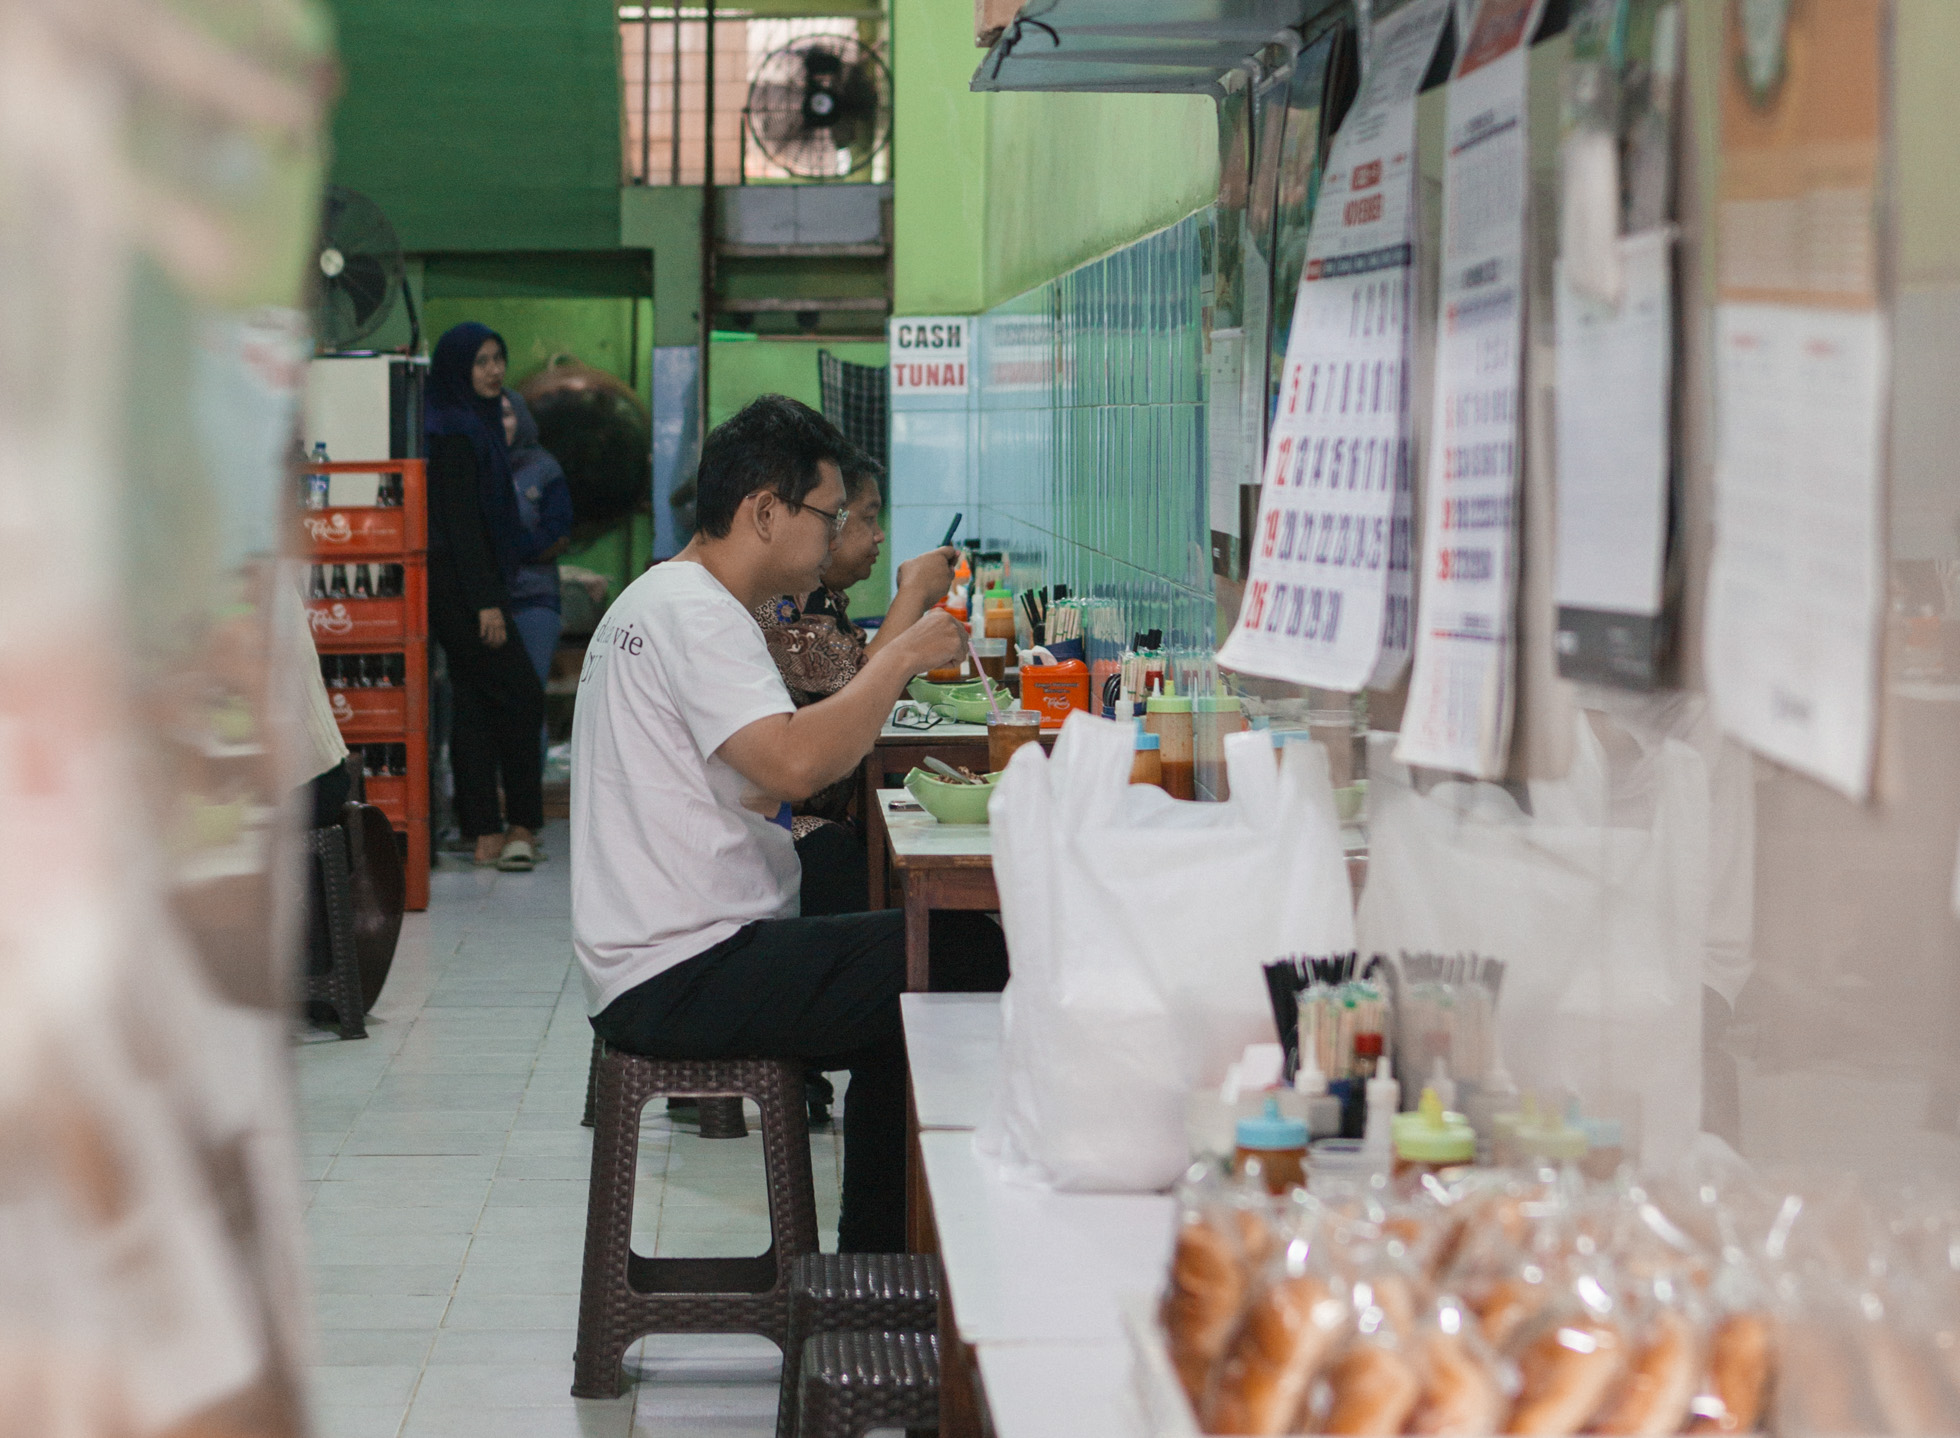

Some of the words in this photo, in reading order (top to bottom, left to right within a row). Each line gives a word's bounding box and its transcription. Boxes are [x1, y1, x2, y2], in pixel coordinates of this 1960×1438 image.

[899, 324, 961, 348] CASH
[894, 364, 964, 387] TUNAI
[1262, 509, 1280, 557] 19
[1245, 580, 1267, 629] 26
[613, 624, 644, 656] vie
